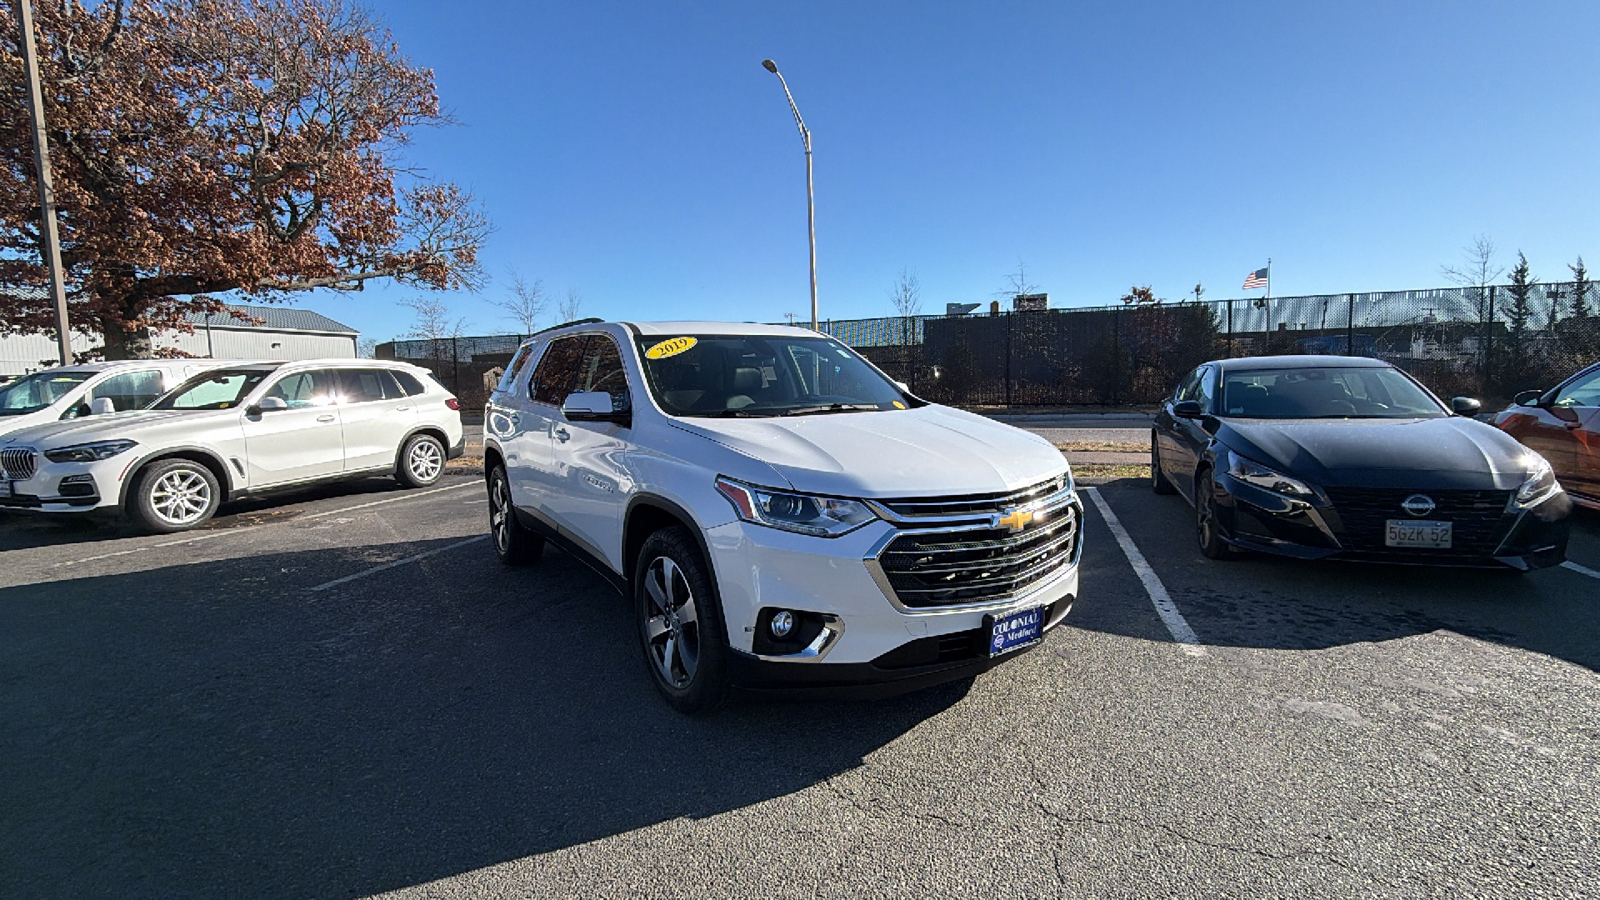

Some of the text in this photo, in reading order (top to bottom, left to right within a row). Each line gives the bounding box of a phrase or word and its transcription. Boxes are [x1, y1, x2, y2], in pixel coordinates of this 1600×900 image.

[656, 338, 688, 356] 2019
[1389, 526, 1449, 543] 5GZK 52
[992, 612, 1040, 636] COLONIAL
[1006, 625, 1037, 642] Medford
